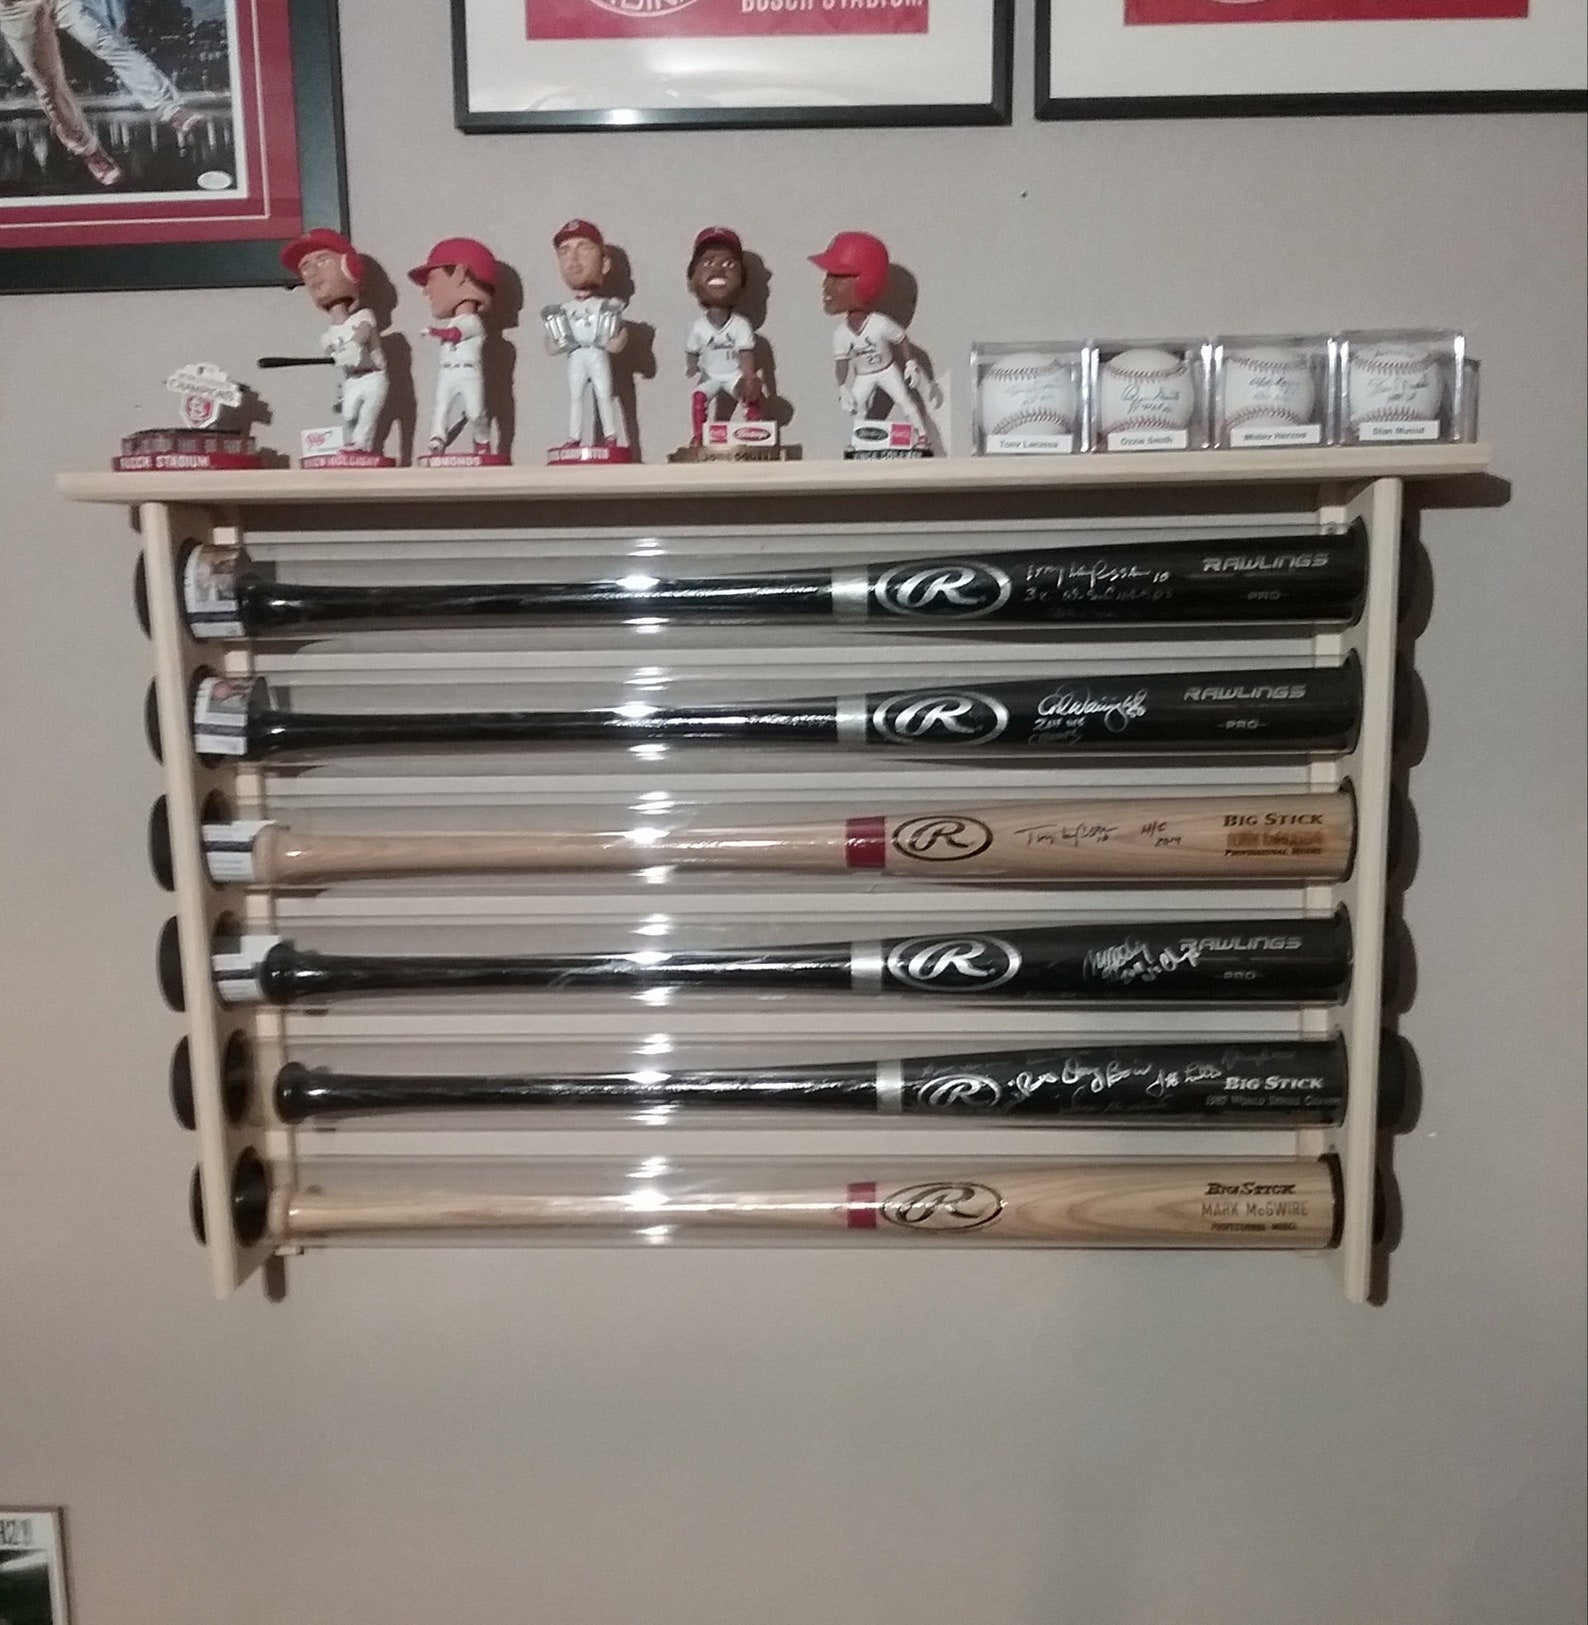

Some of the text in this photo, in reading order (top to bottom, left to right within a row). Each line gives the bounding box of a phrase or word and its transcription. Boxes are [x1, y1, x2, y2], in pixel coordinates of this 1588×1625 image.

[1202, 552, 1330, 572] RAWLINGS
[1183, 684, 1307, 701] RAWLINGS
[1223, 812, 1324, 827] BIG STICK
[1178, 935, 1303, 951] RAWLINGS
[1224, 1074, 1325, 1091] BIG STICK
[1205, 1181, 1296, 1196] BIG STICK
[1202, 1202, 1239, 1217] MARK
